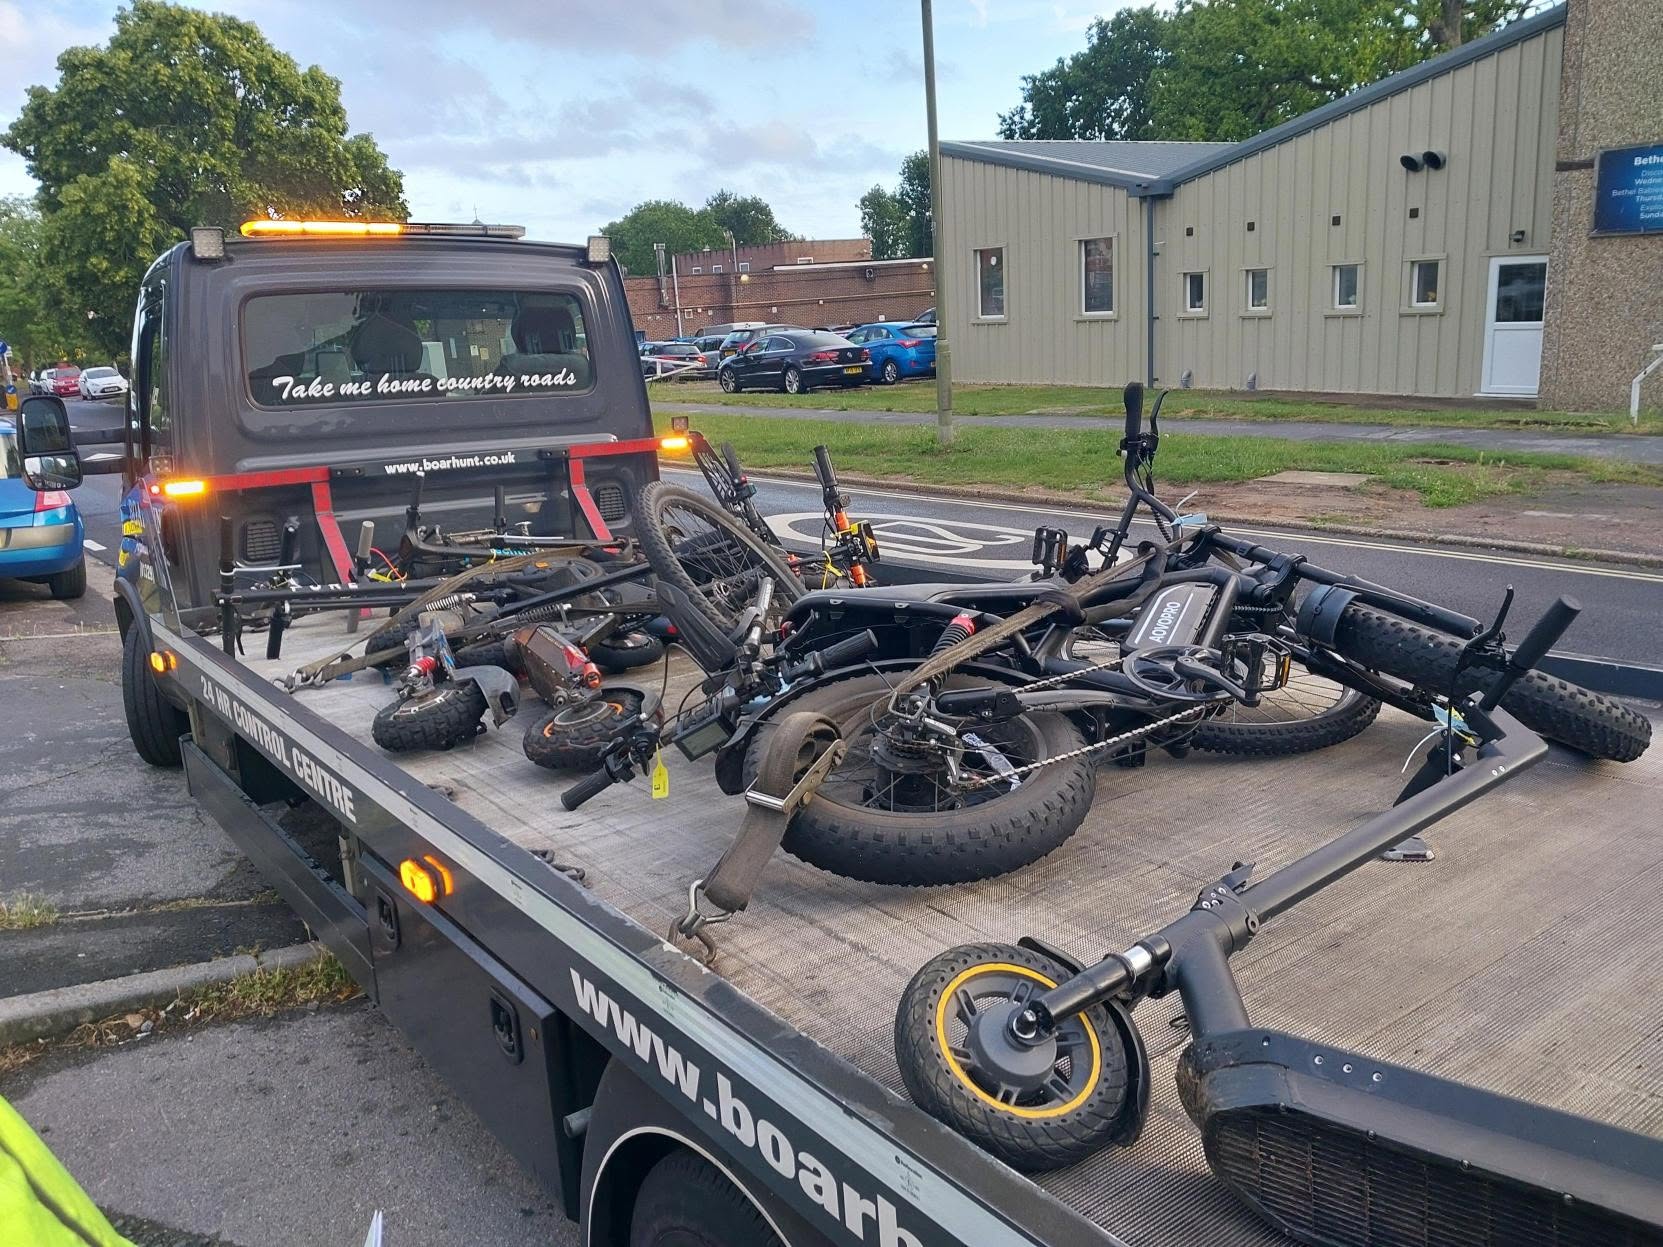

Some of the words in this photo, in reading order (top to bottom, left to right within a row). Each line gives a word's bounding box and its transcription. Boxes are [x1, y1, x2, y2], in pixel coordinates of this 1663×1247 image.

[272, 375, 334, 400] Take
[339, 380, 372, 396] me
[377, 373, 432, 394] home
[436, 370, 516, 393] country
[520, 368, 577, 387] roads
[384, 451, 516, 475] www.boarhunt.co.uk
[1149, 601, 1181, 643] AOVOPRO
[200, 675, 215, 705] 24
[215, 686, 233, 721] HR
[232, 700, 291, 769] CONTROL
[292, 747, 357, 824] CENTRE
